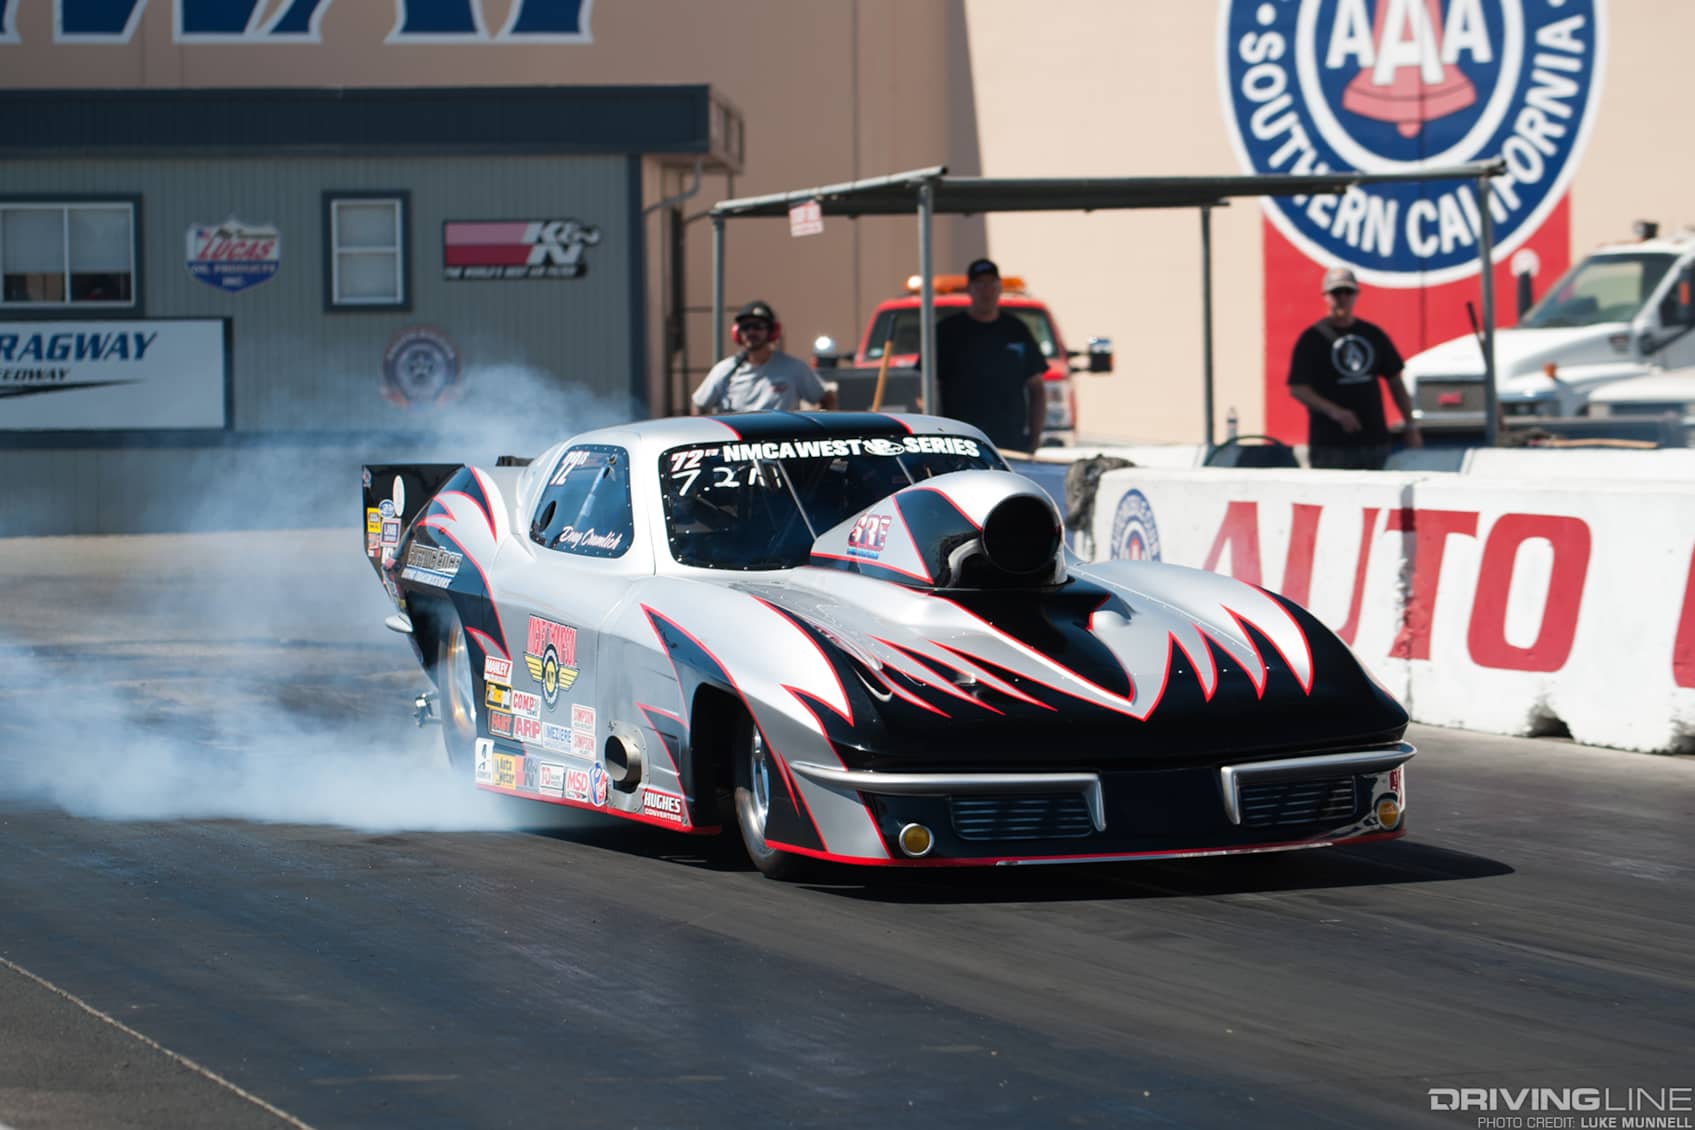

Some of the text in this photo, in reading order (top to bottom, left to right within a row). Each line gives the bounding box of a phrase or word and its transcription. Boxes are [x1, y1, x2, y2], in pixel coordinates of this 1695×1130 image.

[1325, 0, 1492, 86] AAA
[197, 239, 275, 260] LUCAS
[0, 331, 158, 361] RAGWAY
[0, 368, 70, 381] EDWAY
[902, 437, 980, 457] SERIES
[1203, 501, 1592, 672] AUTO
[513, 693, 535, 711] COMP
[515, 717, 541, 739] ARP
[567, 770, 588, 792] MSD
[644, 791, 681, 813] HUGHES
[645, 808, 682, 823] CONVERTERS
